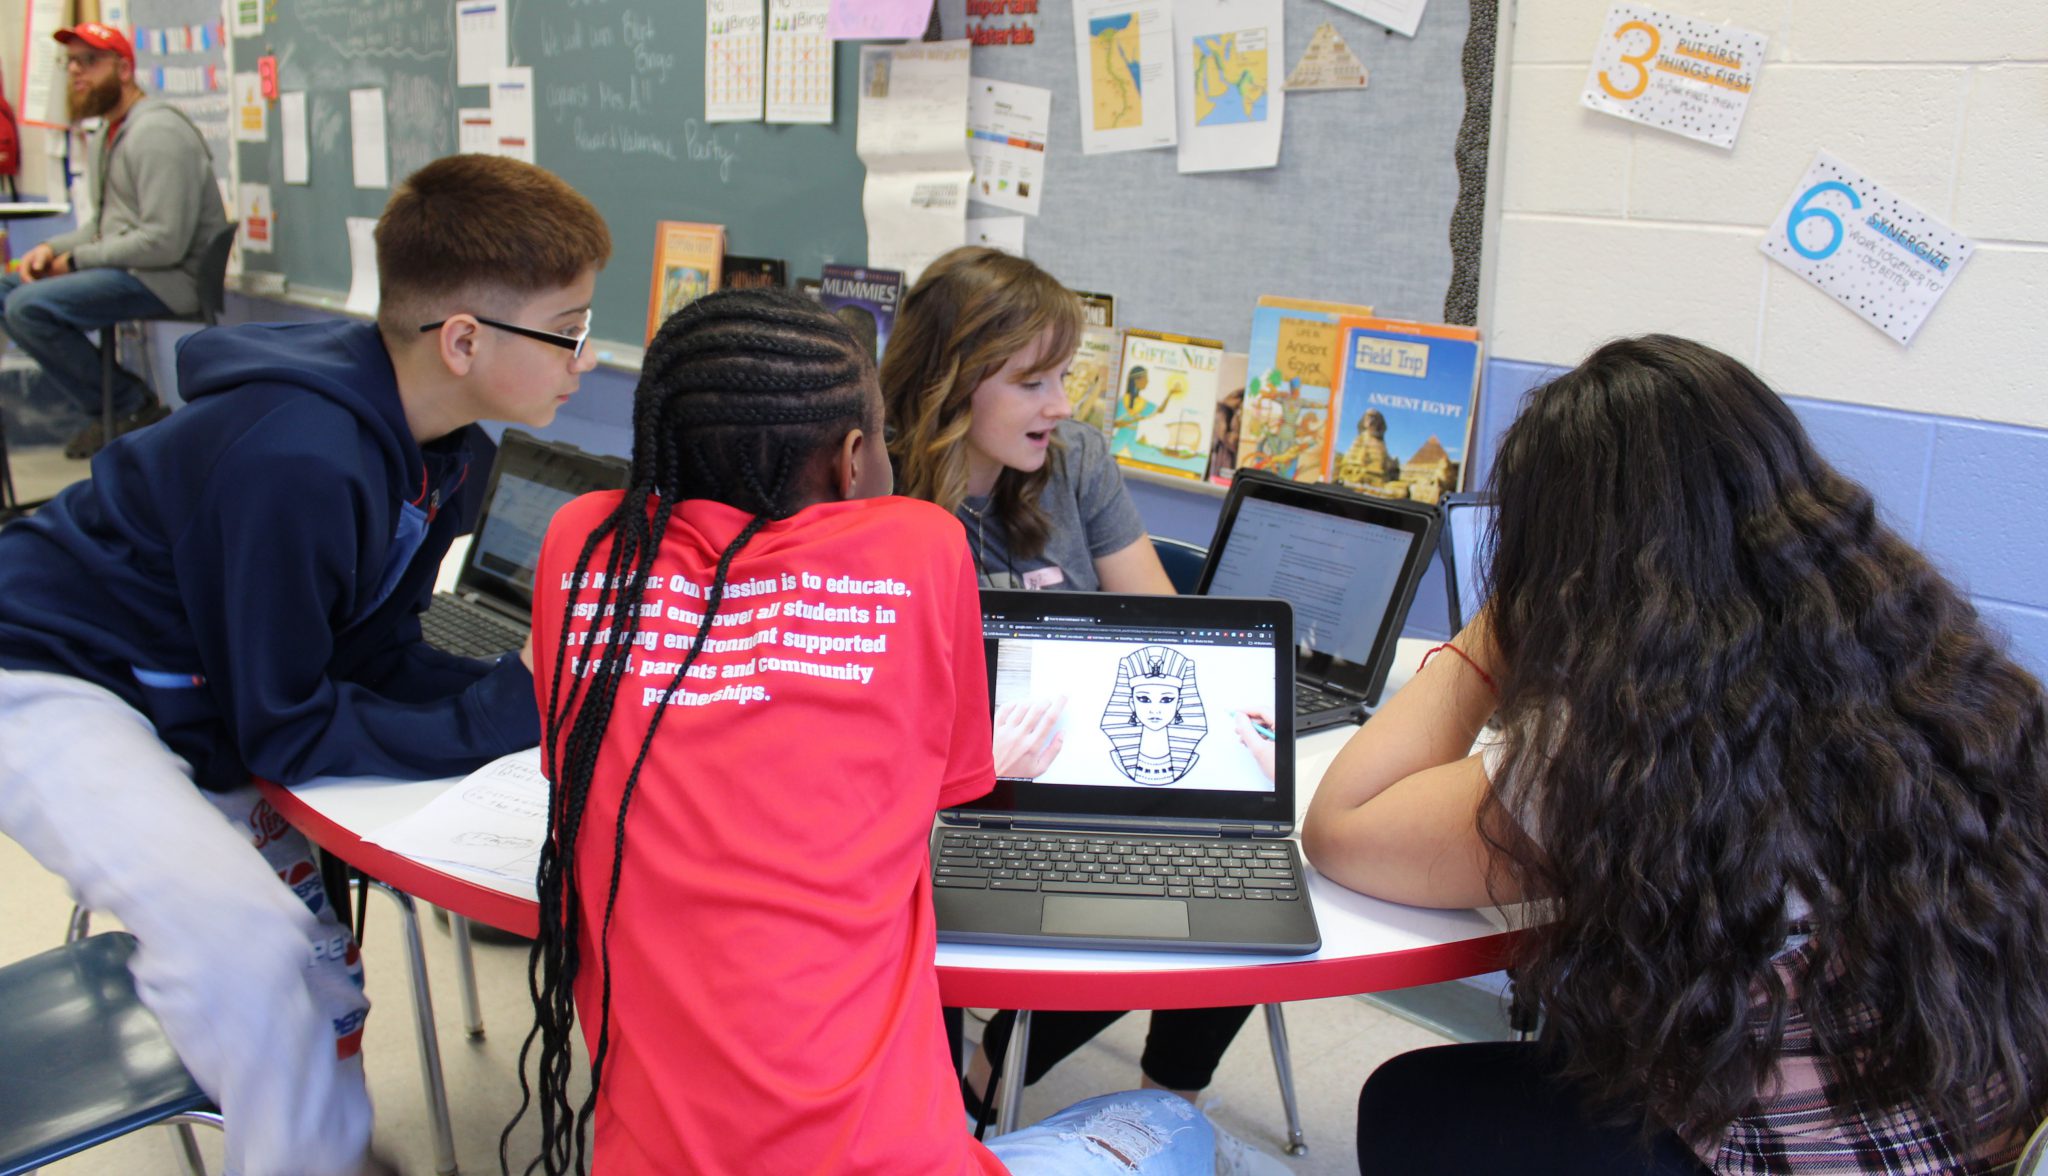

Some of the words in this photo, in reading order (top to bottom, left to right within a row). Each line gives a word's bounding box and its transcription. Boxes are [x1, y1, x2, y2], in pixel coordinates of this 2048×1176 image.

[730, 15, 760, 30] Bingo
[966, 0, 1038, 19] Important
[966, 22, 1034, 46] Materials
[1597, 20, 1661, 100] 3
[1676, 38, 1703, 54] PUT
[1706, 43, 1745, 65] FIRST
[1656, 54, 1711, 80] THINGS
[1714, 68, 1753, 89] FIRST
[1786, 180, 1863, 260] 6
[1869, 212, 1951, 271] SYNERGIZE
[820, 278, 898, 303] MUMMIES
[1285, 339, 1328, 357] Ancient
[1358, 343, 1393, 367] Field
[1398, 349, 1424, 372] Trip
[1287, 355, 1321, 377] Egypt
[1367, 391, 1421, 412] ANCIENT
[1422, 400, 1463, 418] EGYPT
[781, 573, 797, 591] is
[802, 572, 822, 590] to
[826, 575, 912, 598] educate,
[756, 602, 781, 620] all
[783, 600, 870, 623] students
[876, 605, 896, 623] in
[567, 632, 576, 646] a
[783, 631, 886, 654] supported
[721, 658, 756, 678] and
[758, 657, 874, 684] community
